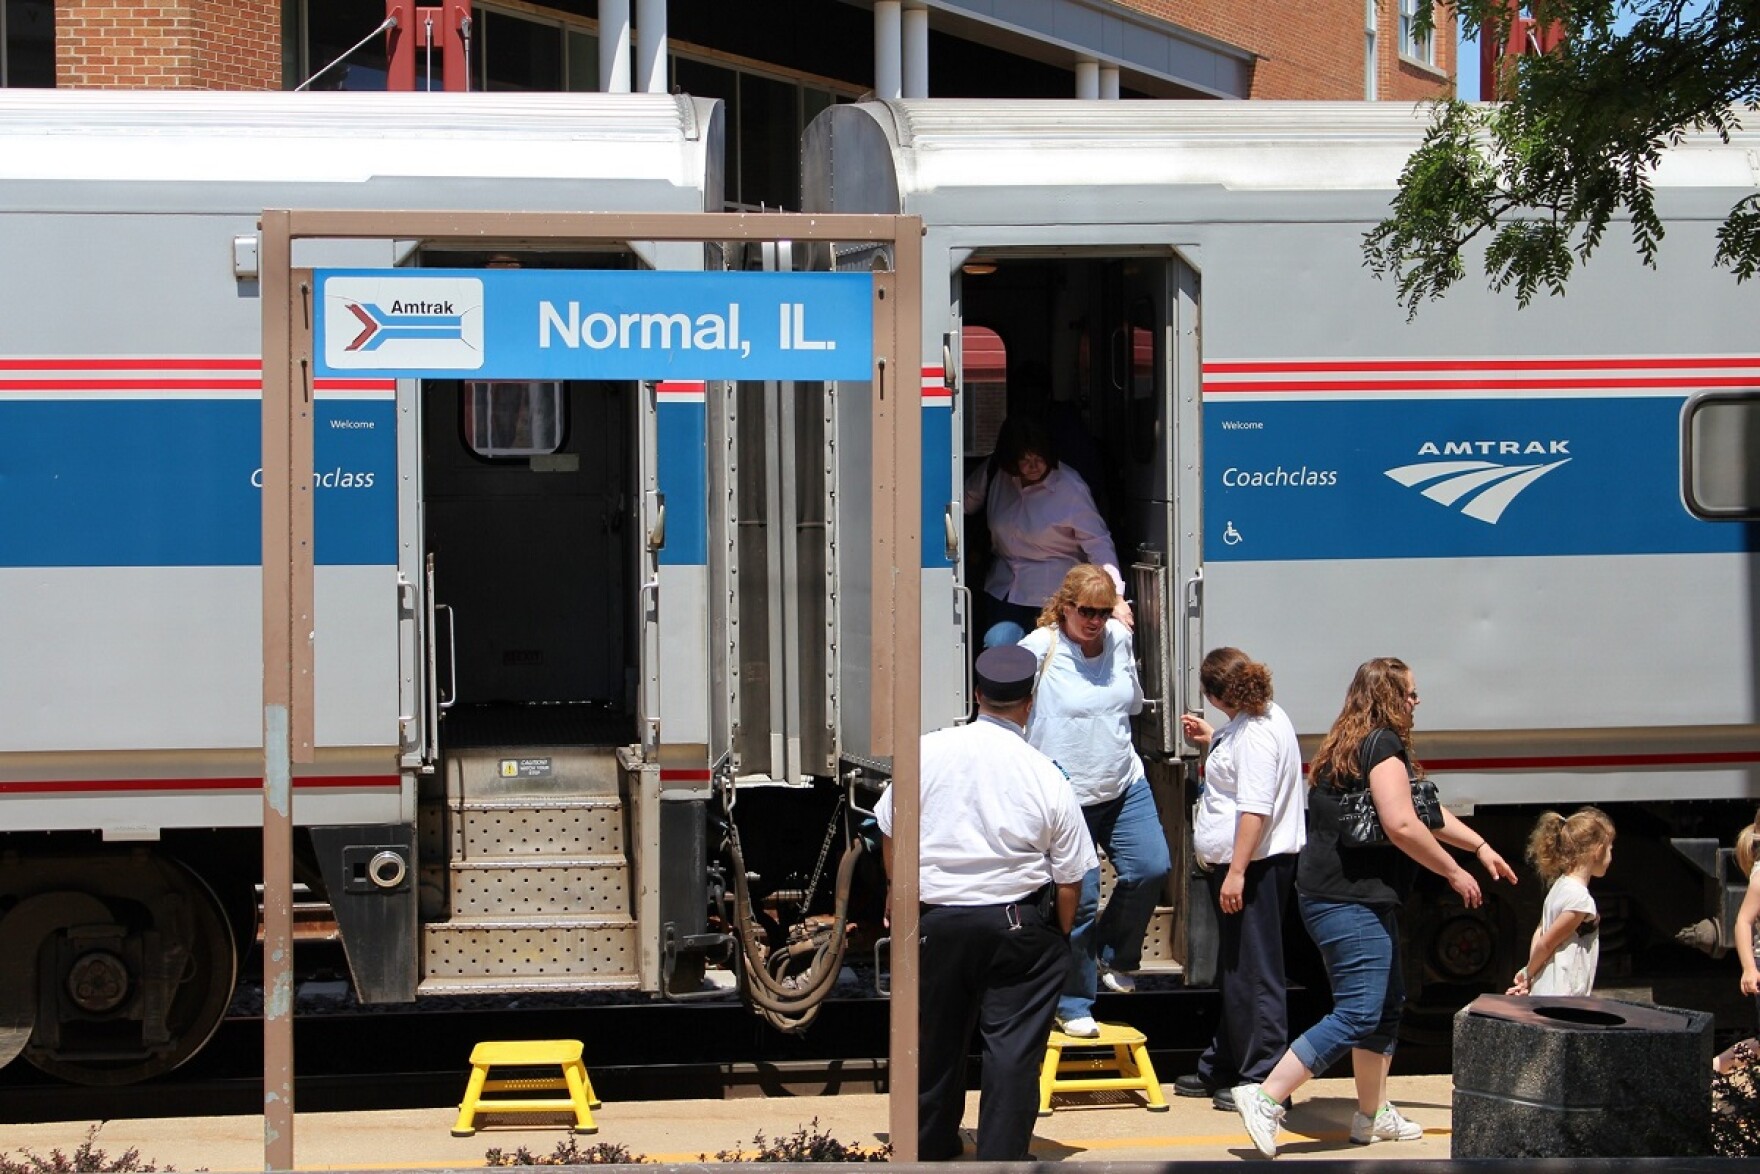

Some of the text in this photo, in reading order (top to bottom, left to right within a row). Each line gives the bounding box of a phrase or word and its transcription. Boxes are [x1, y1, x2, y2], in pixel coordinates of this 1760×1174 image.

[391, 300, 454, 315] Amtrak
[539, 301, 837, 359] Normal, IL.
[329, 419, 375, 429] Welcome
[1221, 420, 1264, 430] Welcome
[1417, 440, 1570, 456] AMTRAK
[250, 467, 375, 488] Cclass
[1222, 465, 1338, 487] Coachclass
